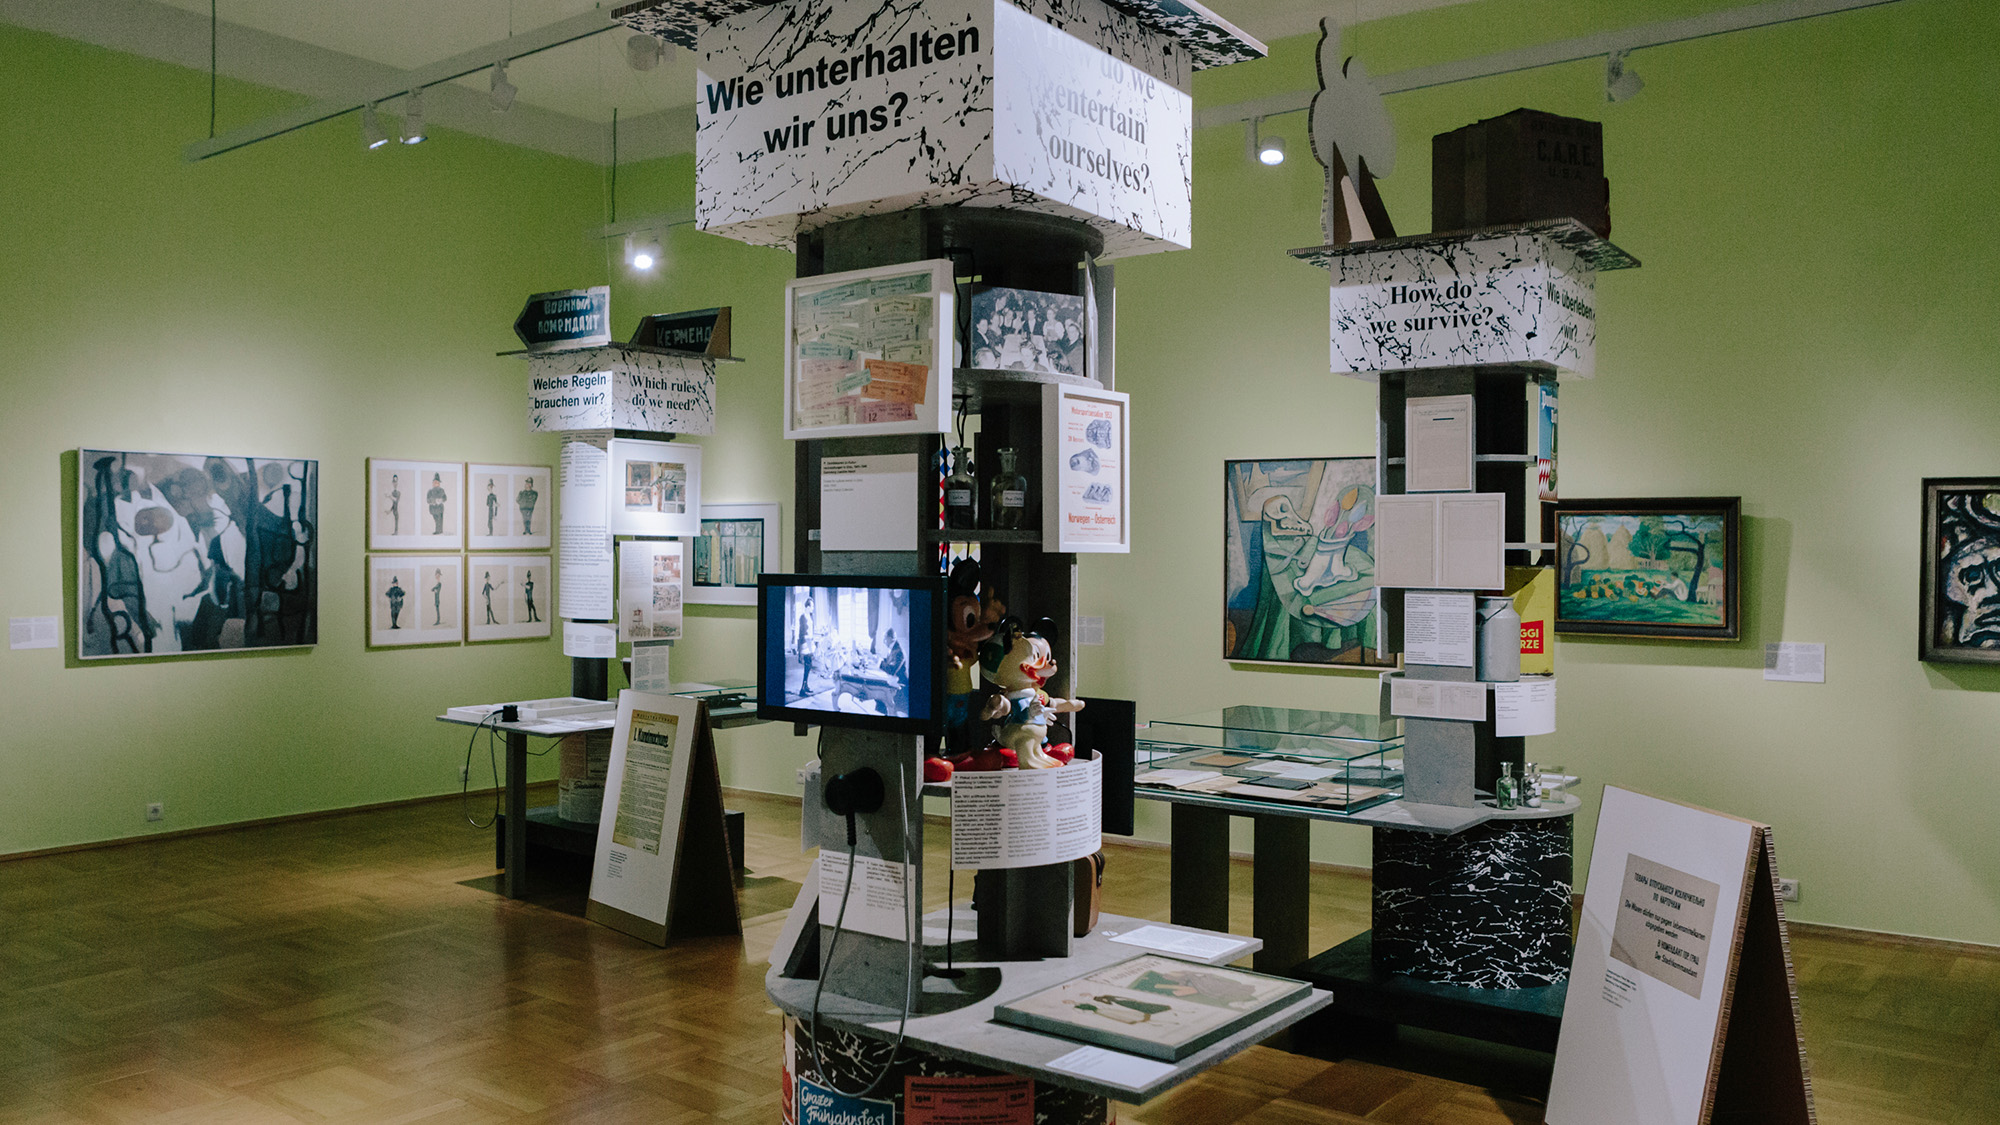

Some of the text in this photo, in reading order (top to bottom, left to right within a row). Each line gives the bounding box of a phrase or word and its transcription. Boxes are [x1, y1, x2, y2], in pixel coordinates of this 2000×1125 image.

[707, 26, 979, 114] Wie unterhalten
[1100, 46, 1124, 84] do
[1131, 68, 1155, 99] we
[764, 92, 908, 154] wir uns?
[1056, 84, 1146, 145] entertain
[1049, 134, 1150, 195] ourselves?
[1390, 281, 1472, 306] How do
[1547, 281, 1593, 321] Wie überleben
[1370, 306, 1493, 337] we survive?
[1563, 322, 1578, 342] wir?
[533, 374, 606, 390] Welche Regeln
[632, 375, 697, 393] Which rules
[535, 392, 604, 409] brauchen wir?
[632, 394, 697, 411] do we need?
[1068, 512, 1091, 525] Norwegen
[1660, 915, 1673, 928] gegen
[801, 1086, 834, 1106] Grazer
